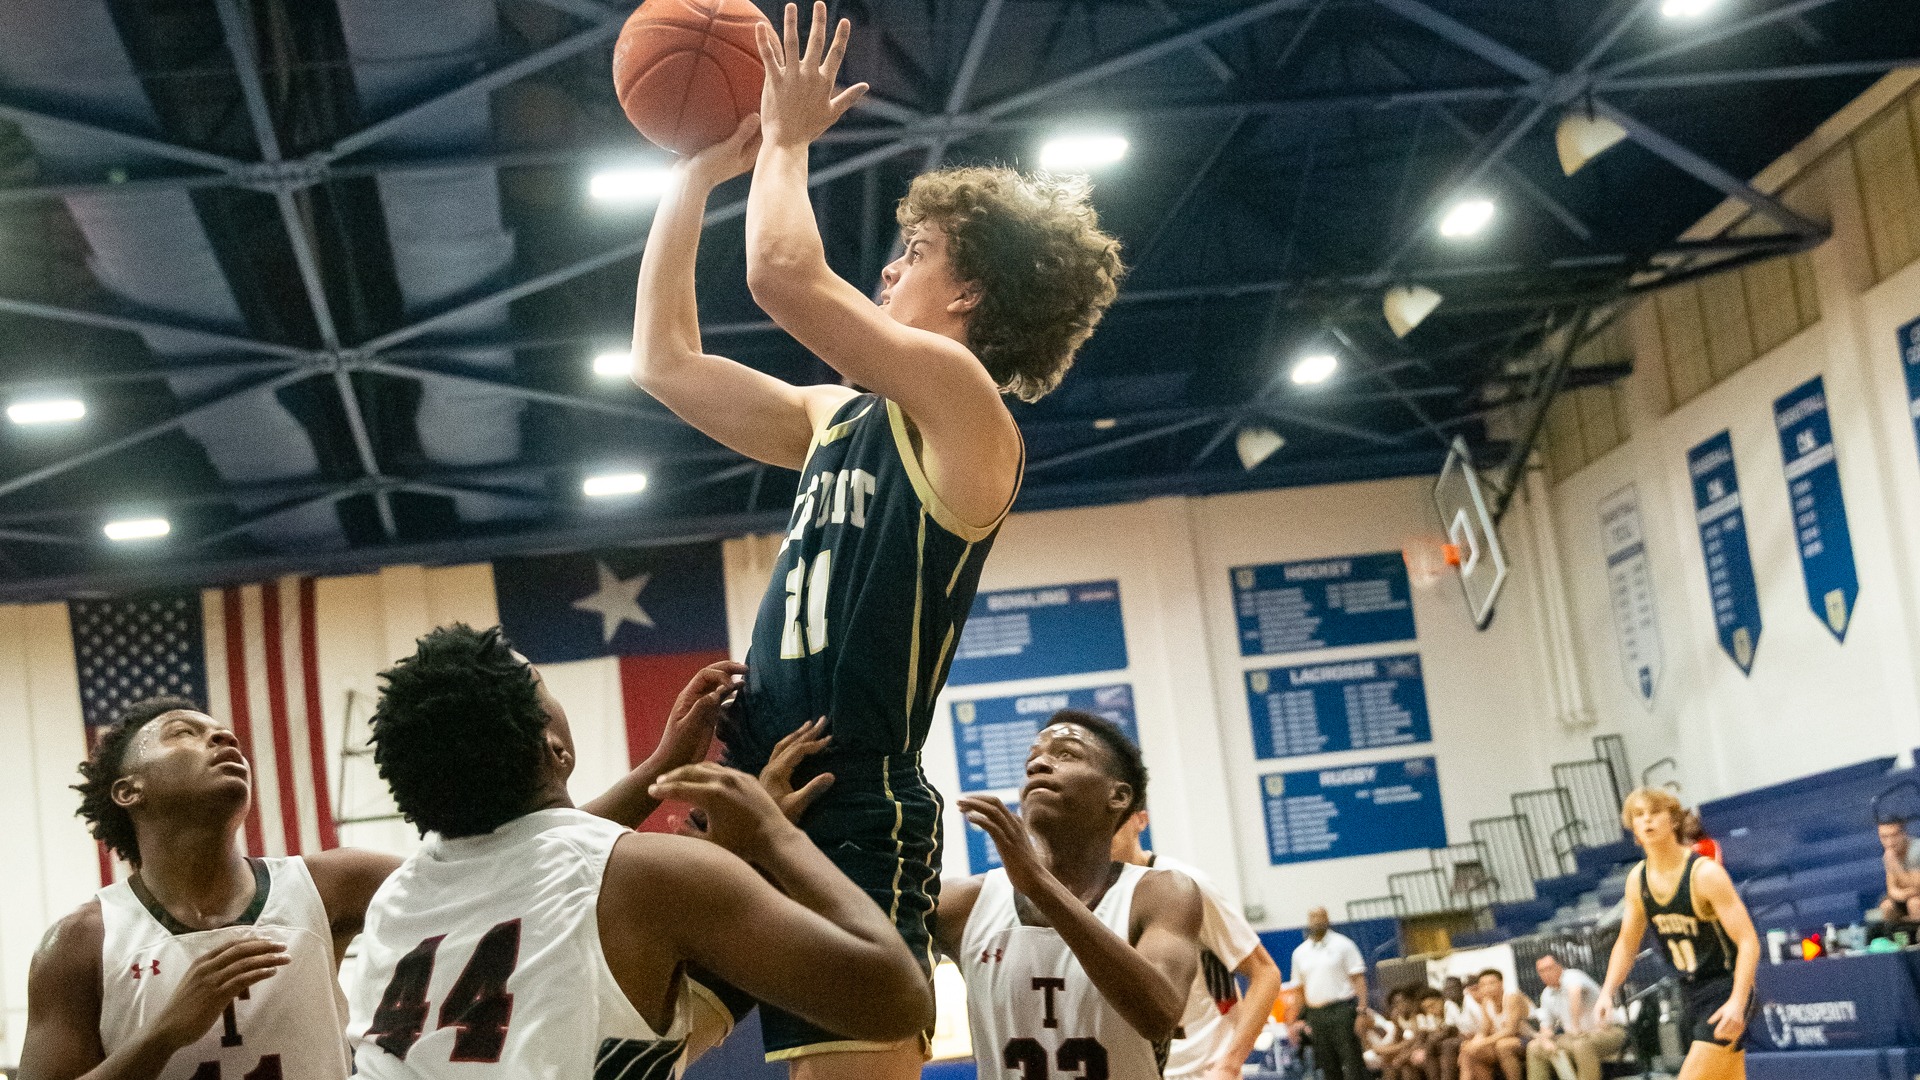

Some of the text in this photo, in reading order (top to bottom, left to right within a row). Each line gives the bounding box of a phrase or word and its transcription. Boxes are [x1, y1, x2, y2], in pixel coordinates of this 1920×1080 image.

[1290, 661, 1377, 686] LACROSSE
[1319, 766, 1378, 788] RUGBY
[363, 917, 522, 1063] 44
[1032, 977, 1065, 1029] T
